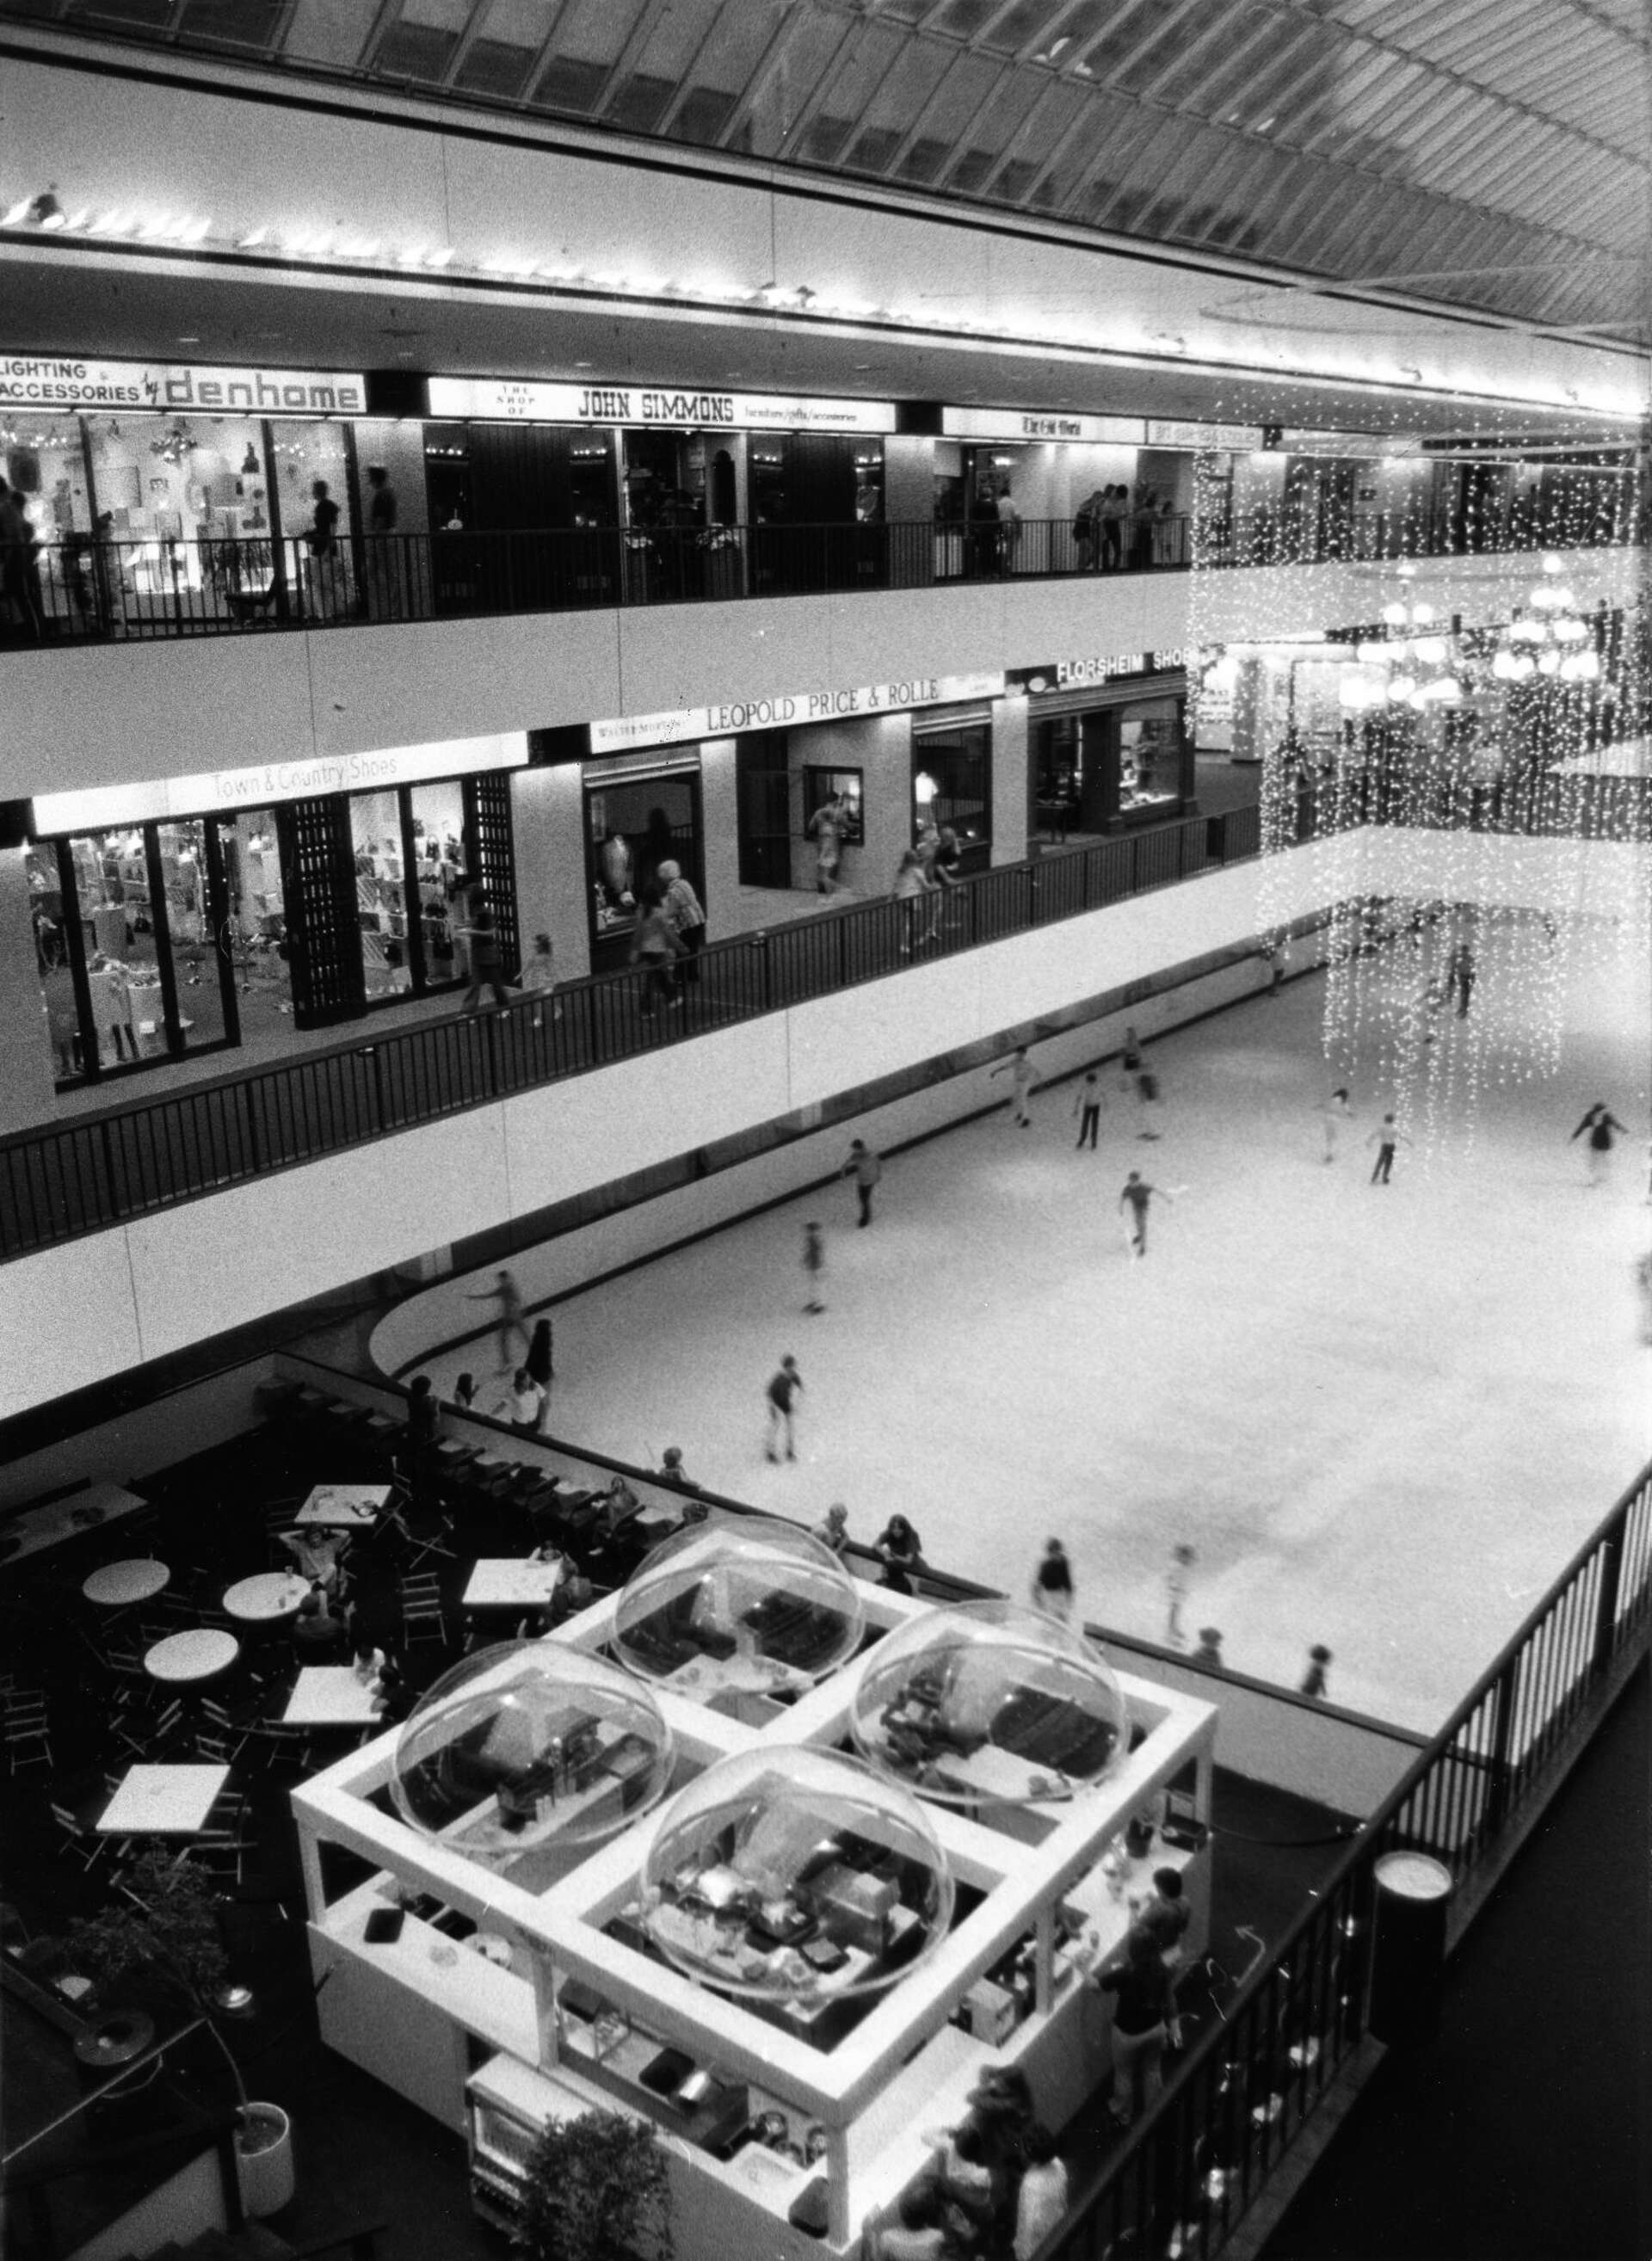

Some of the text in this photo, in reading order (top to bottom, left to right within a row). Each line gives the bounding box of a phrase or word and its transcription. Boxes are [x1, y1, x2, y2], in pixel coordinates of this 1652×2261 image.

[0, 383, 139, 401] ACCESSORIES
[166, 370, 359, 409] denhome
[579, 391, 734, 422] JOHN SIMMONS
[1057, 653, 1143, 682] FLORSHEIM
[706, 679, 938, 730] LEOPOLD PRICE & ROLLE
[212, 773, 259, 799] Town
[276, 765, 344, 790] Country
[349, 755, 398, 779] Shoes
